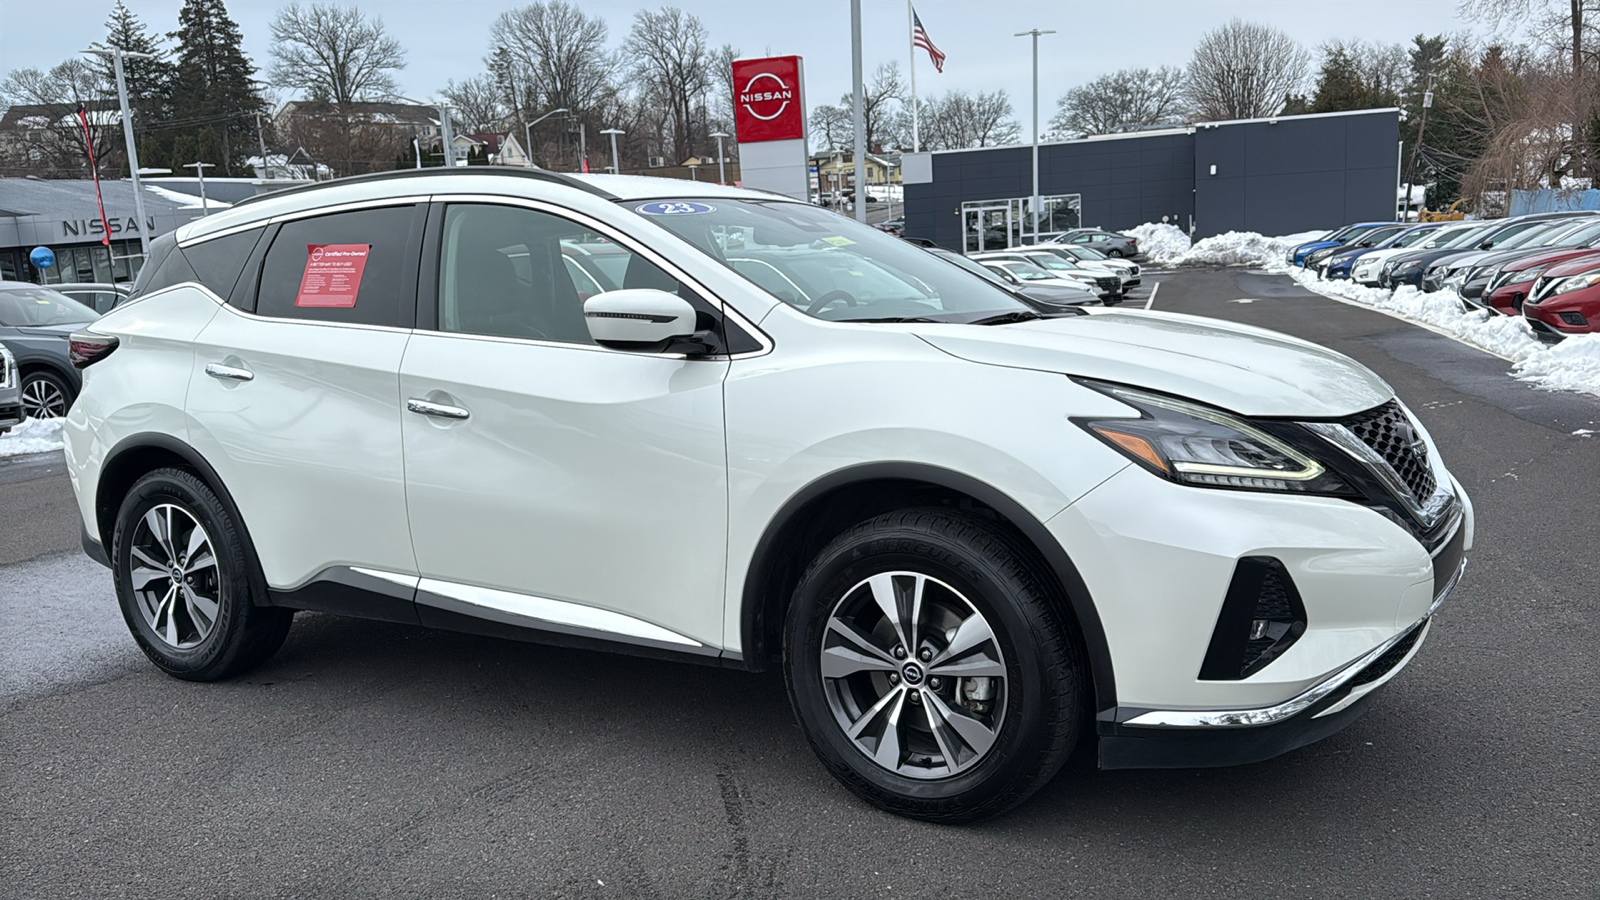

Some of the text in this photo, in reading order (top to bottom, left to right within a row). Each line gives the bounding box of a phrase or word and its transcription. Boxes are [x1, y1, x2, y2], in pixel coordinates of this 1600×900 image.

[740, 90, 792, 103] NISSAN
[658, 203, 696, 214] 23
[62, 216, 154, 236] NISSAN
[869, 538, 985, 582] HERCULES
